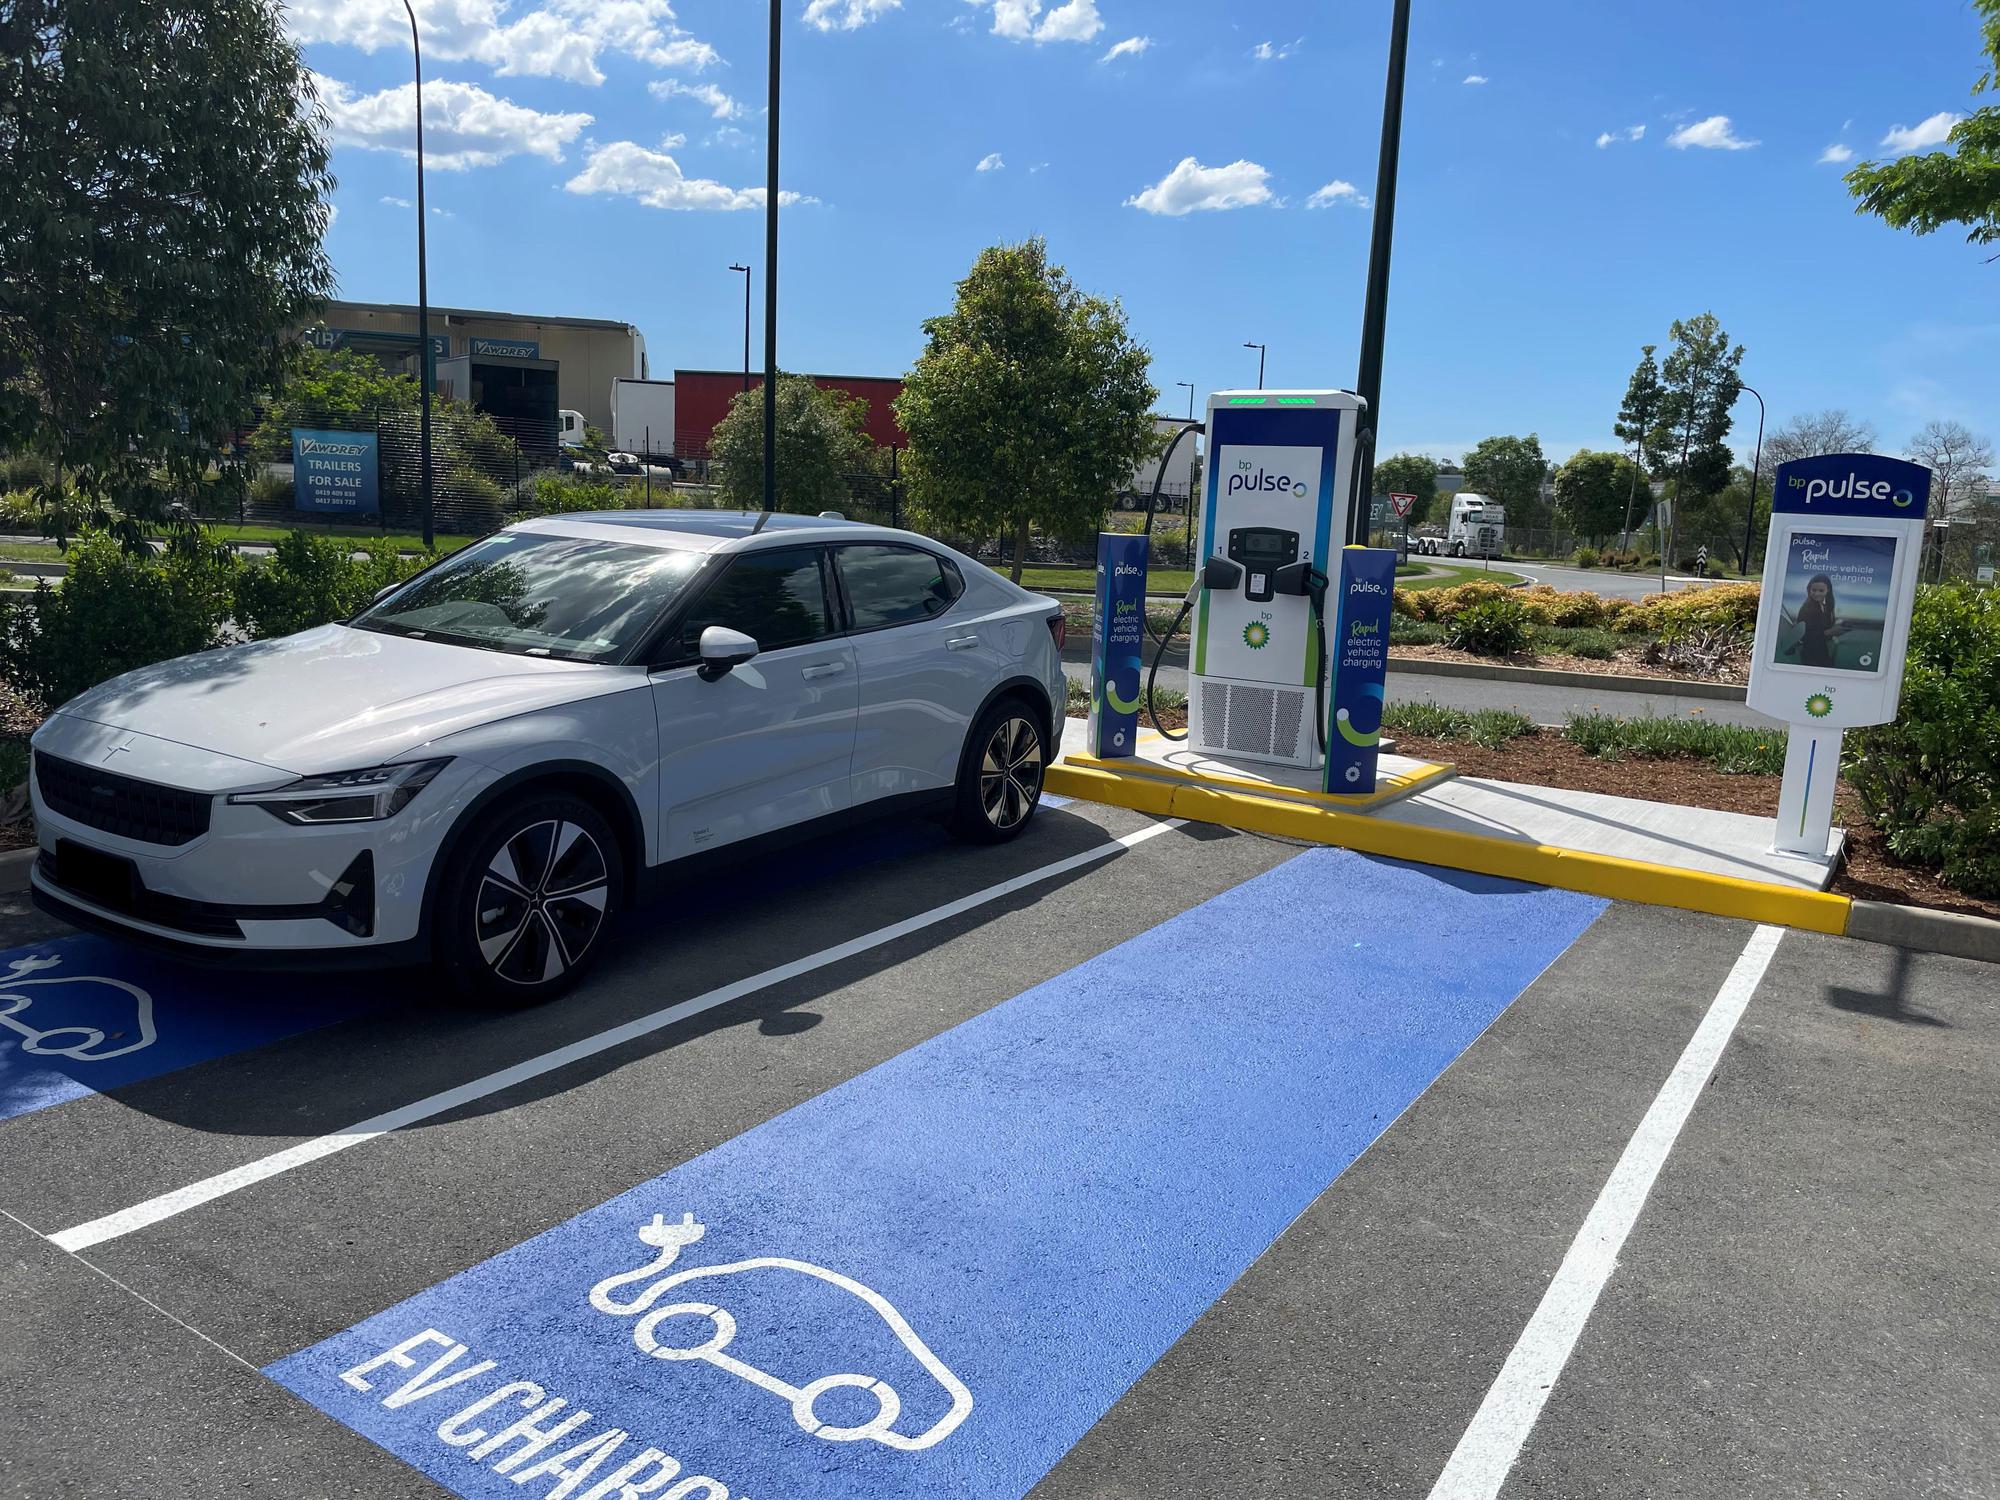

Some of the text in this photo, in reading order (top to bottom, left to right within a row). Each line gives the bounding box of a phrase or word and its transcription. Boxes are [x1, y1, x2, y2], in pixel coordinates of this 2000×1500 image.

[474, 340, 534, 358] VAWDREY
[300, 438, 368, 456] VAWDREY
[308, 460, 361, 472] TRAILERS
[1238, 459, 1252, 470] bp
[309, 475, 362, 488] FOR SALE
[1228, 468, 1291, 496] pulse
[1788, 472, 1891, 503] bp pulse
[1792, 537, 1816, 547] pulse
[1218, 546, 1223, 554] 1
[1303, 551, 1309, 560] 2
[1801, 549, 1829, 563] Rapid
[1114, 564, 1138, 577] pulse
[1803, 564, 1874, 574] electric vehicle
[1831, 573, 1873, 584] charging
[1350, 581, 1380, 595] pulse
[1115, 597, 1137, 615] Rapid
[1113, 616, 1139, 624] electric
[1261, 611, 1273, 620] bp
[1113, 624, 1138, 633] vehicle
[1350, 618, 1379, 637] Rapid
[1110, 634, 1140, 644] charging
[1347, 638, 1381, 647] electric
[1347, 648, 1380, 657] vehicle
[1342, 658, 1382, 669] charging
[1824, 685, 1836, 693] bp
[338, 1328, 499, 1409] EV
